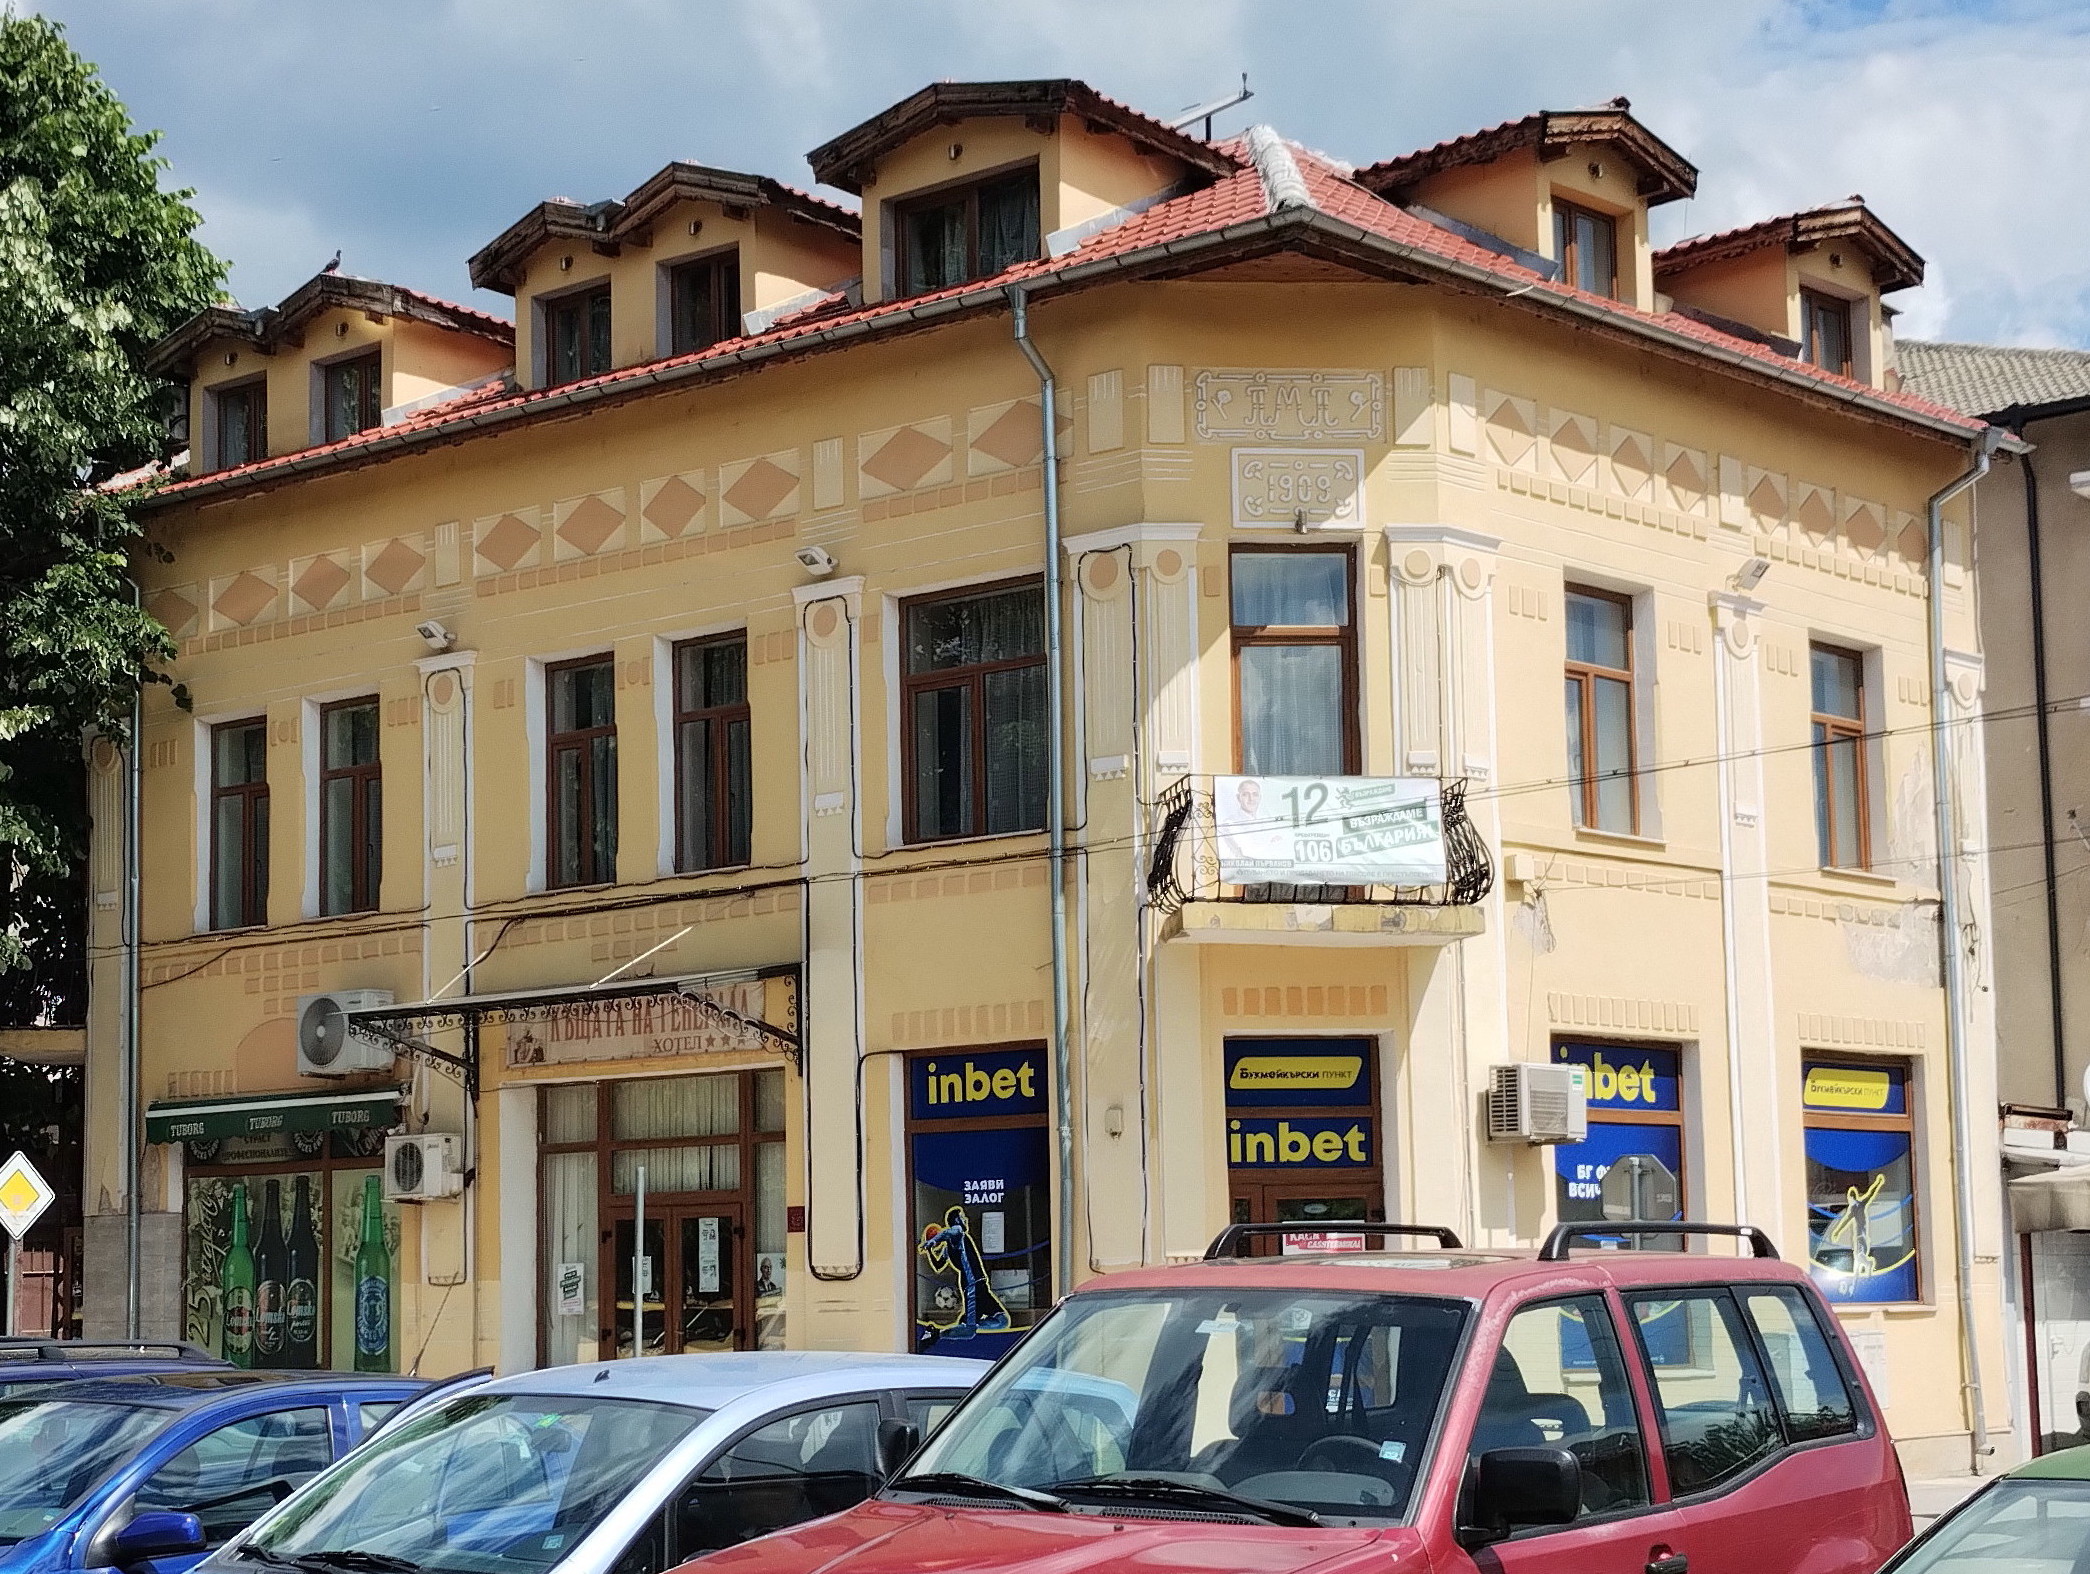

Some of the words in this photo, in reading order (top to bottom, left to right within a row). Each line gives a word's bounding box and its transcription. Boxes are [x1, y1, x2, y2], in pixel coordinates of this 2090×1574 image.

[1268, 475, 1330, 502] 1909
[1282, 783, 1329, 829] 12
[1296, 840, 1332, 862] 106
[654, 1036, 703, 1054] ХОТЕЛ
[928, 1060, 1035, 1104] inbet
[1322, 1070, 1353, 1079] ПУНКТ
[249, 1115, 284, 1130] TUBORG
[332, 1109, 370, 1125] TUBORG
[170, 1122, 204, 1137] TUBORG
[1230, 1119, 1366, 1163] inbet
[1577, 1165, 1593, 1180] БГ
[963, 1179, 1004, 1191] ЗАЯВИ
[964, 1192, 1005, 1204] ЗАЛОГ
[187, 1283, 212, 1348] 25
